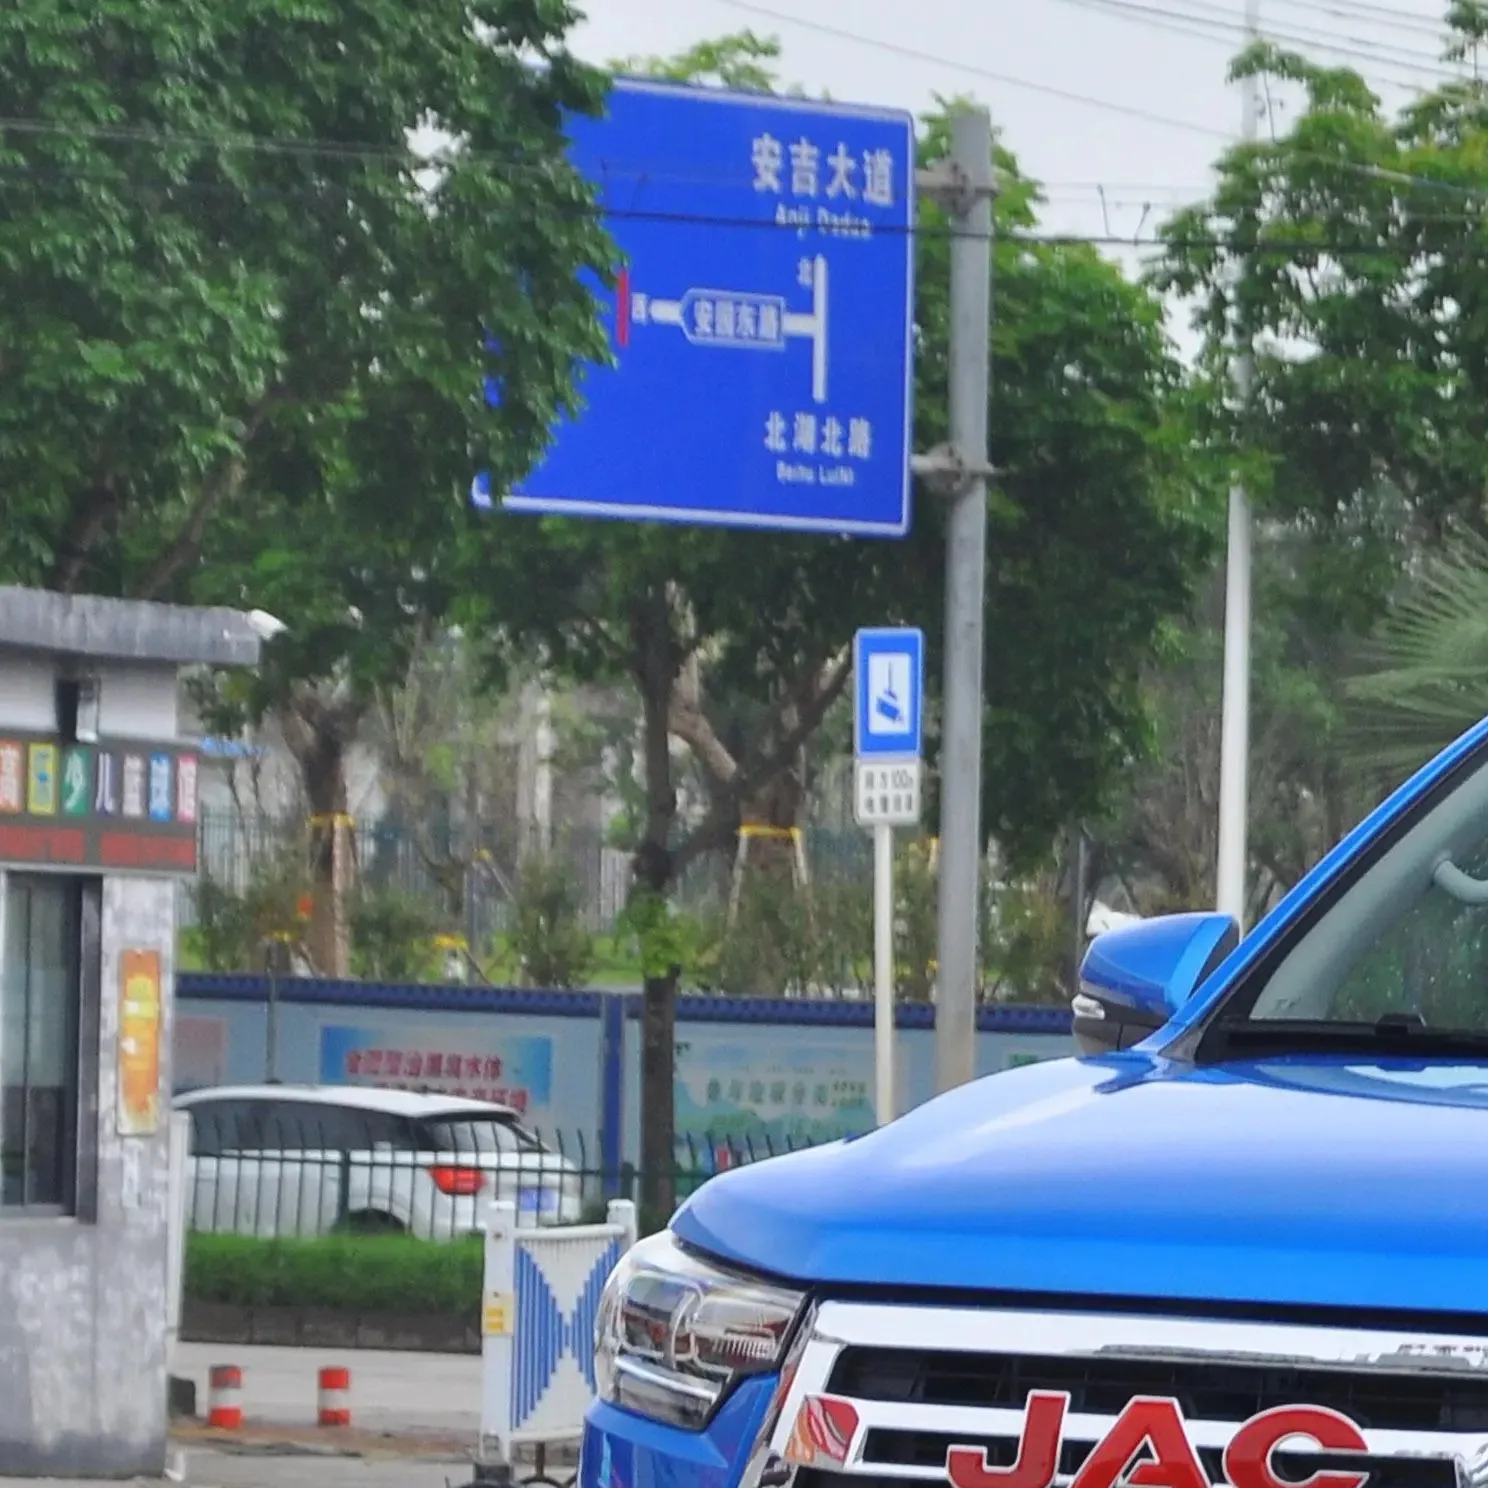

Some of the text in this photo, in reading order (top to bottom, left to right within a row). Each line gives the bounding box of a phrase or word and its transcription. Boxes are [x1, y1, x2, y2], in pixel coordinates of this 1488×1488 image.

[751, 131, 893, 208] 安吉大道
[763, 410, 871, 460] 北湖北路
